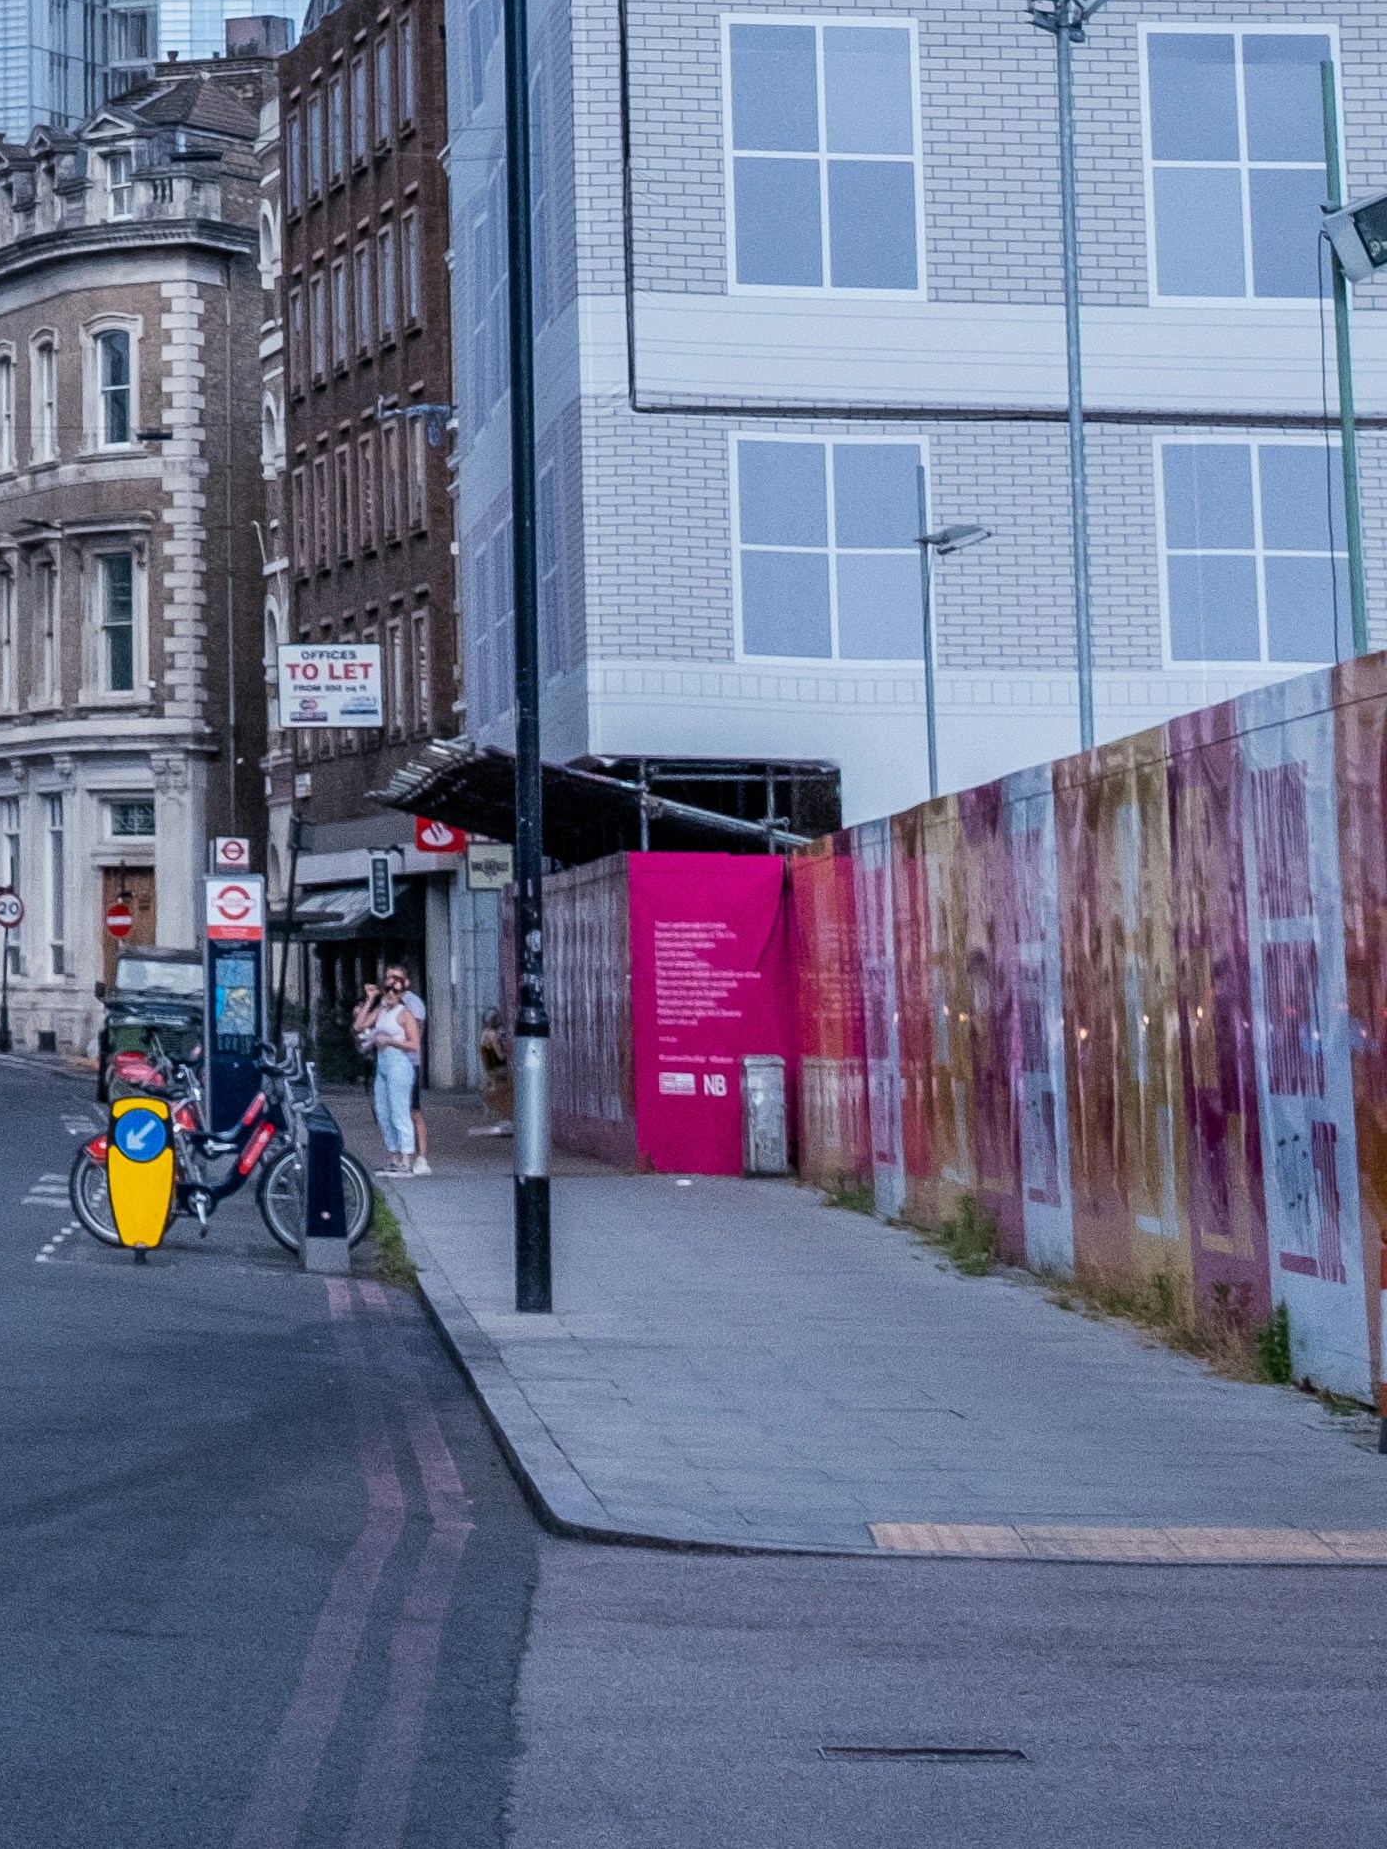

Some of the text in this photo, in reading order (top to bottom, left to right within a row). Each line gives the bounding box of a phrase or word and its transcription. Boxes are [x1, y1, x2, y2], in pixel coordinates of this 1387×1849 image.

[300, 650, 357, 660] OFFICES
[285, 663, 373, 680] TO LET
